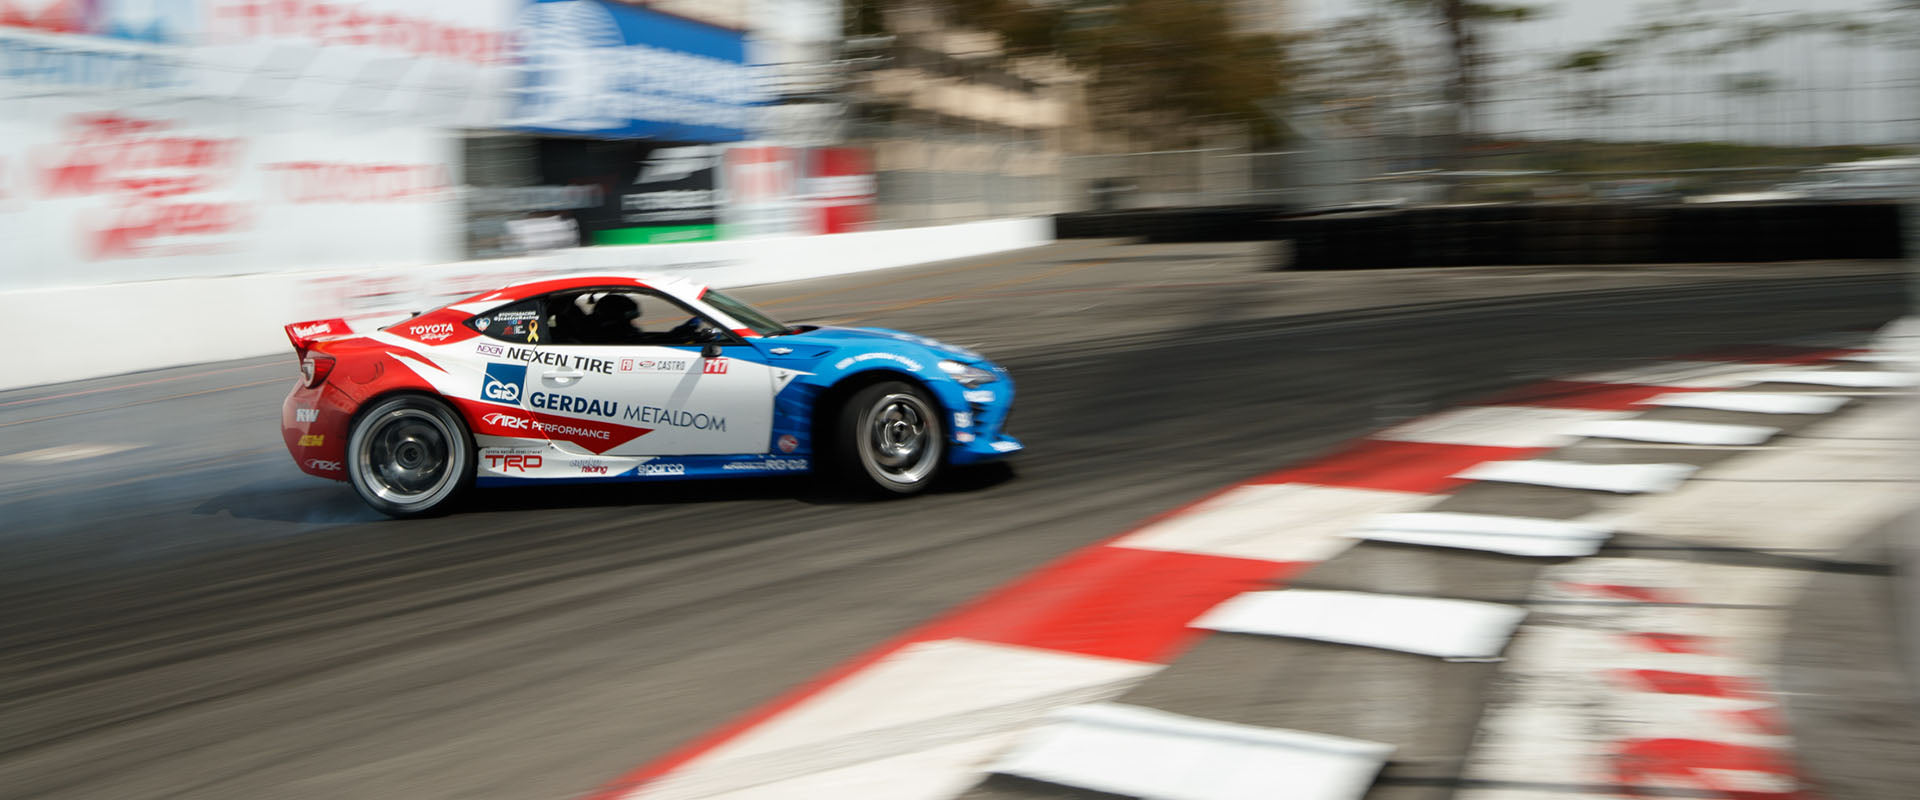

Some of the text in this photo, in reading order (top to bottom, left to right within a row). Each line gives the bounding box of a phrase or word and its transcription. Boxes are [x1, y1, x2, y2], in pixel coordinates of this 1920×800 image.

[410, 323, 454, 335] TOYOTA
[507, 347, 614, 375] NEXEN TIRE
[705, 360, 728, 374] 717
[530, 391, 727, 432] GERDAU METALDOM
[531, 420, 610, 440] PERFORMANCE
[485, 455, 542, 472] TRD
[581, 465, 608, 475] racing
[637, 463, 685, 476] sparco
